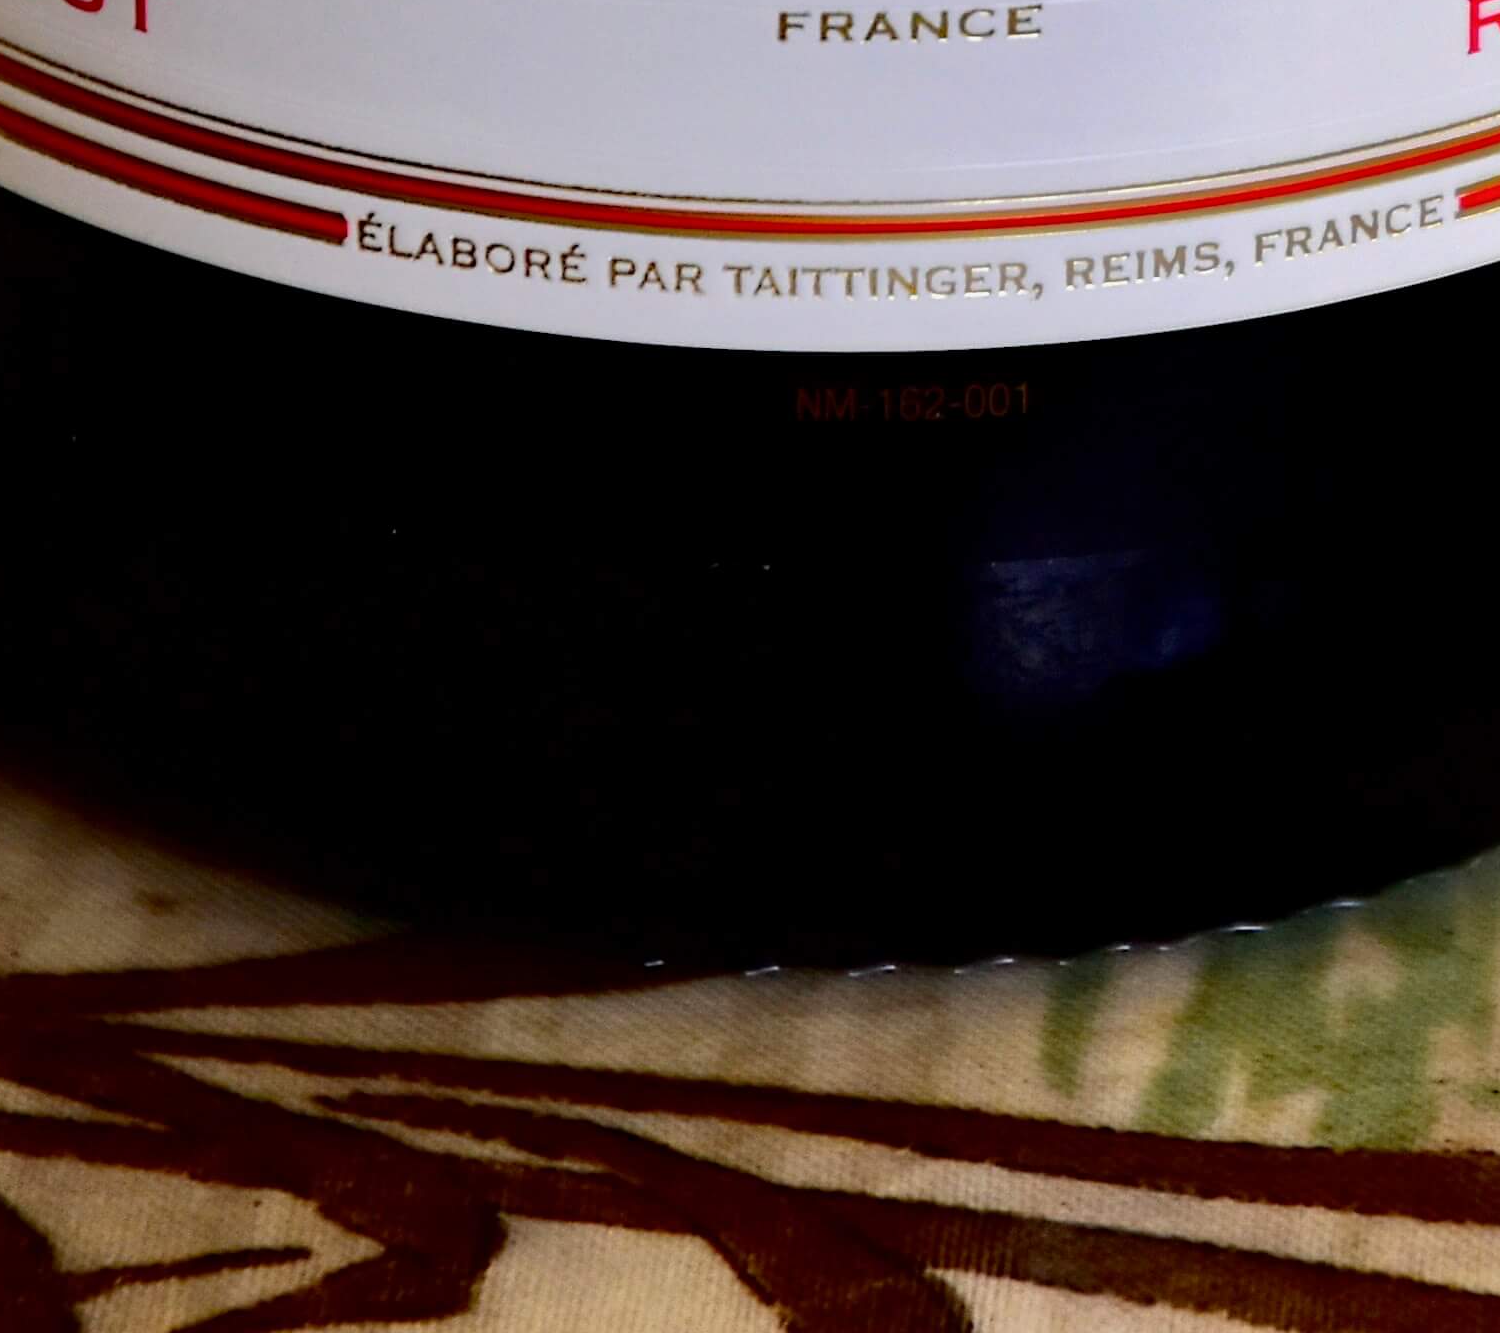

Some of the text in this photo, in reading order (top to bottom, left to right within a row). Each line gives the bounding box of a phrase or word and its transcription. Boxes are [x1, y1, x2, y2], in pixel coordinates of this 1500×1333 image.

[777, 4, 1044, 44] FRANCE
[356, 192, 1445, 301] ÉLABORÉ PAR TAITTINGER, REIMS, FRANCE
